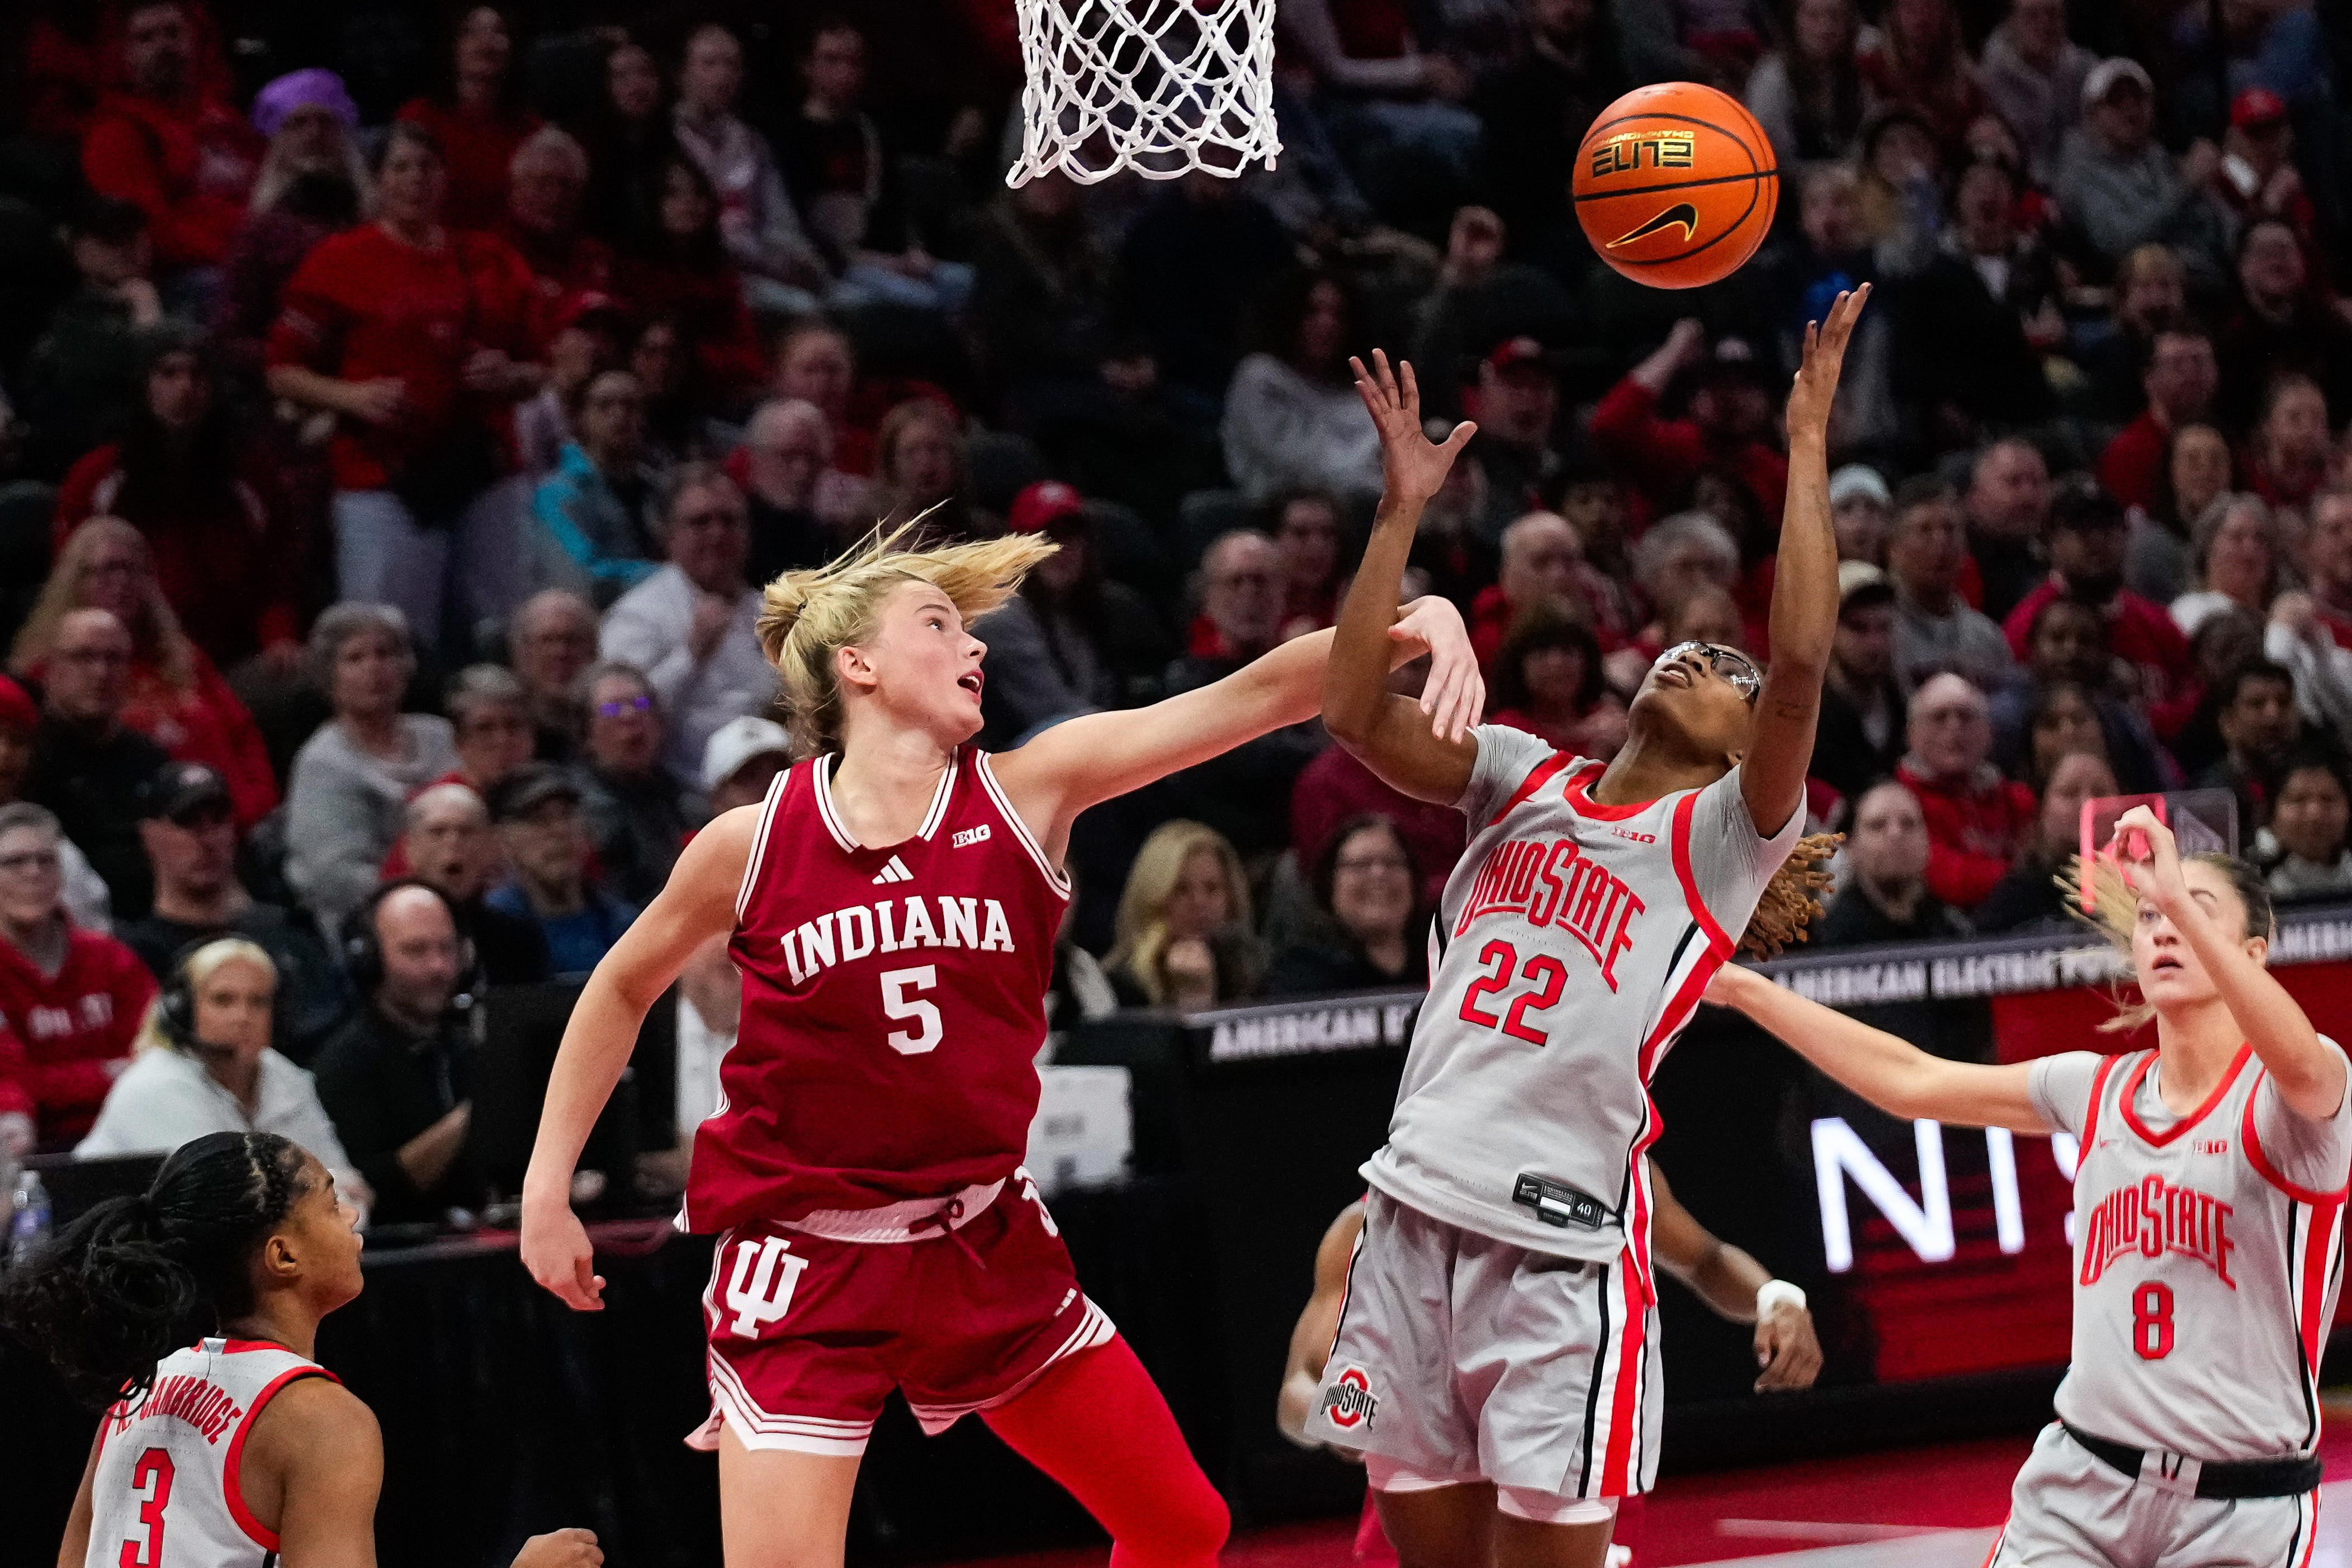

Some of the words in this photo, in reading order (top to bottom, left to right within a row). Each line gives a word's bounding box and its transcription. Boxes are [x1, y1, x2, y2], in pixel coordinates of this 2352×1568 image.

[1592, 139, 1695, 178] ELITE
[780, 896, 1015, 986] INDIANA
[880, 964, 943, 1055] 5
[1459, 939, 1569, 1046] 22
[1577, 1202, 1592, 1217] 40
[2133, 1280, 2174, 1361] 8
[119, 1447, 176, 1568] 3
